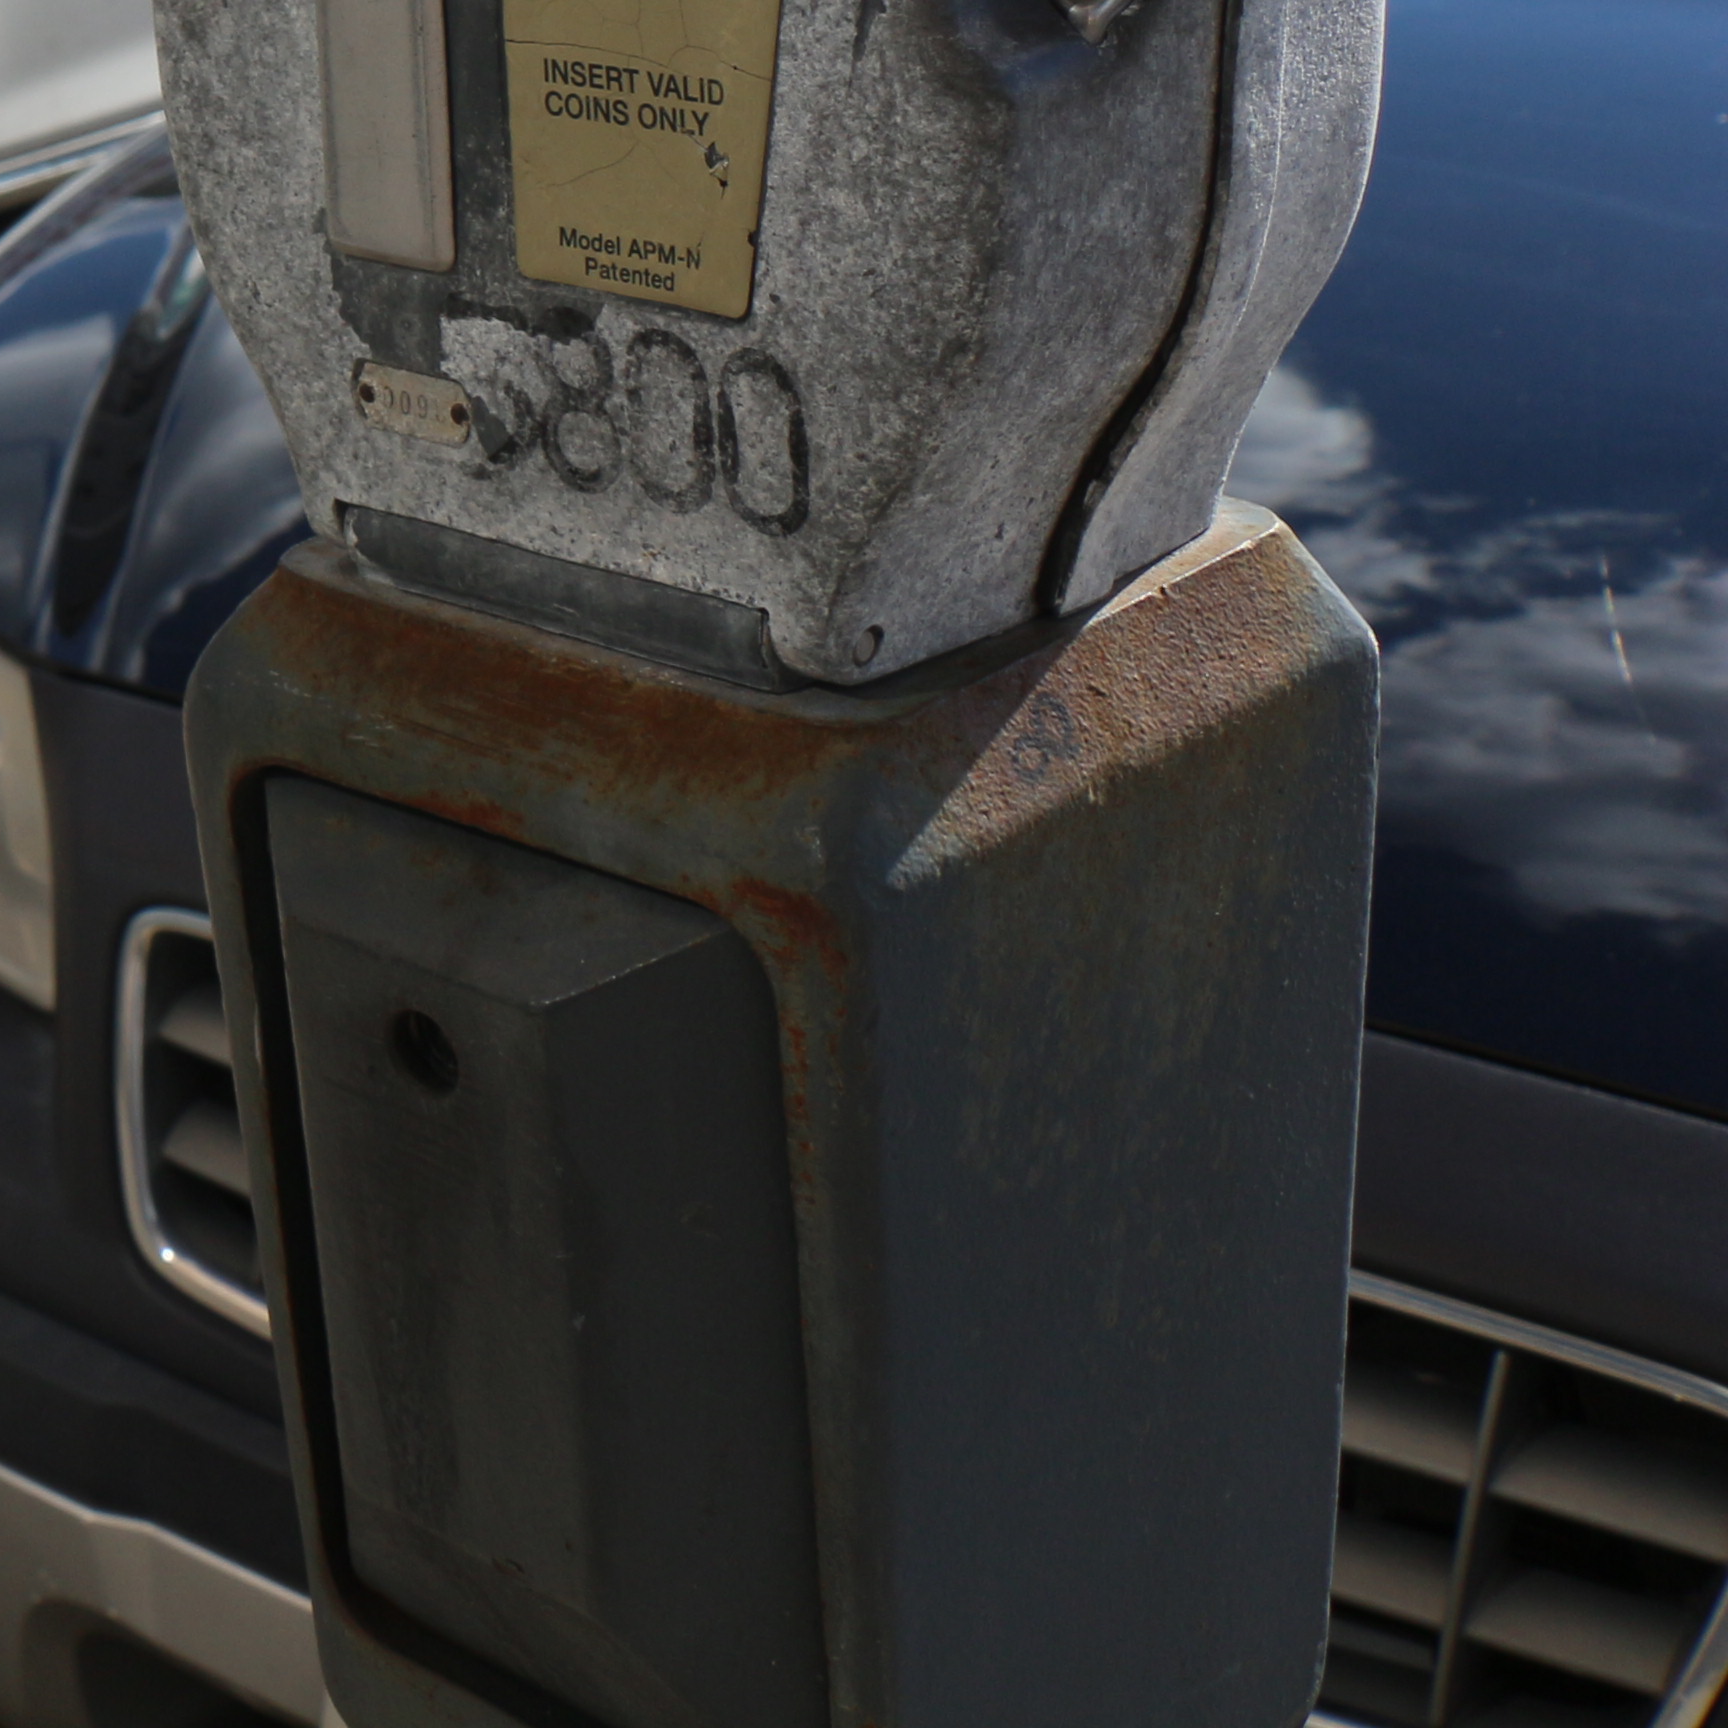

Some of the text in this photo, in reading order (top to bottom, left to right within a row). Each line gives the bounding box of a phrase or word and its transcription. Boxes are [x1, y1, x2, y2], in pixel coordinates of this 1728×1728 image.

[543, 57, 725, 106] INSERT VALID
[544, 90, 710, 137] COINS ONLY
[558, 225, 701, 271] Model APM-N
[584, 255, 676, 293] Patented
